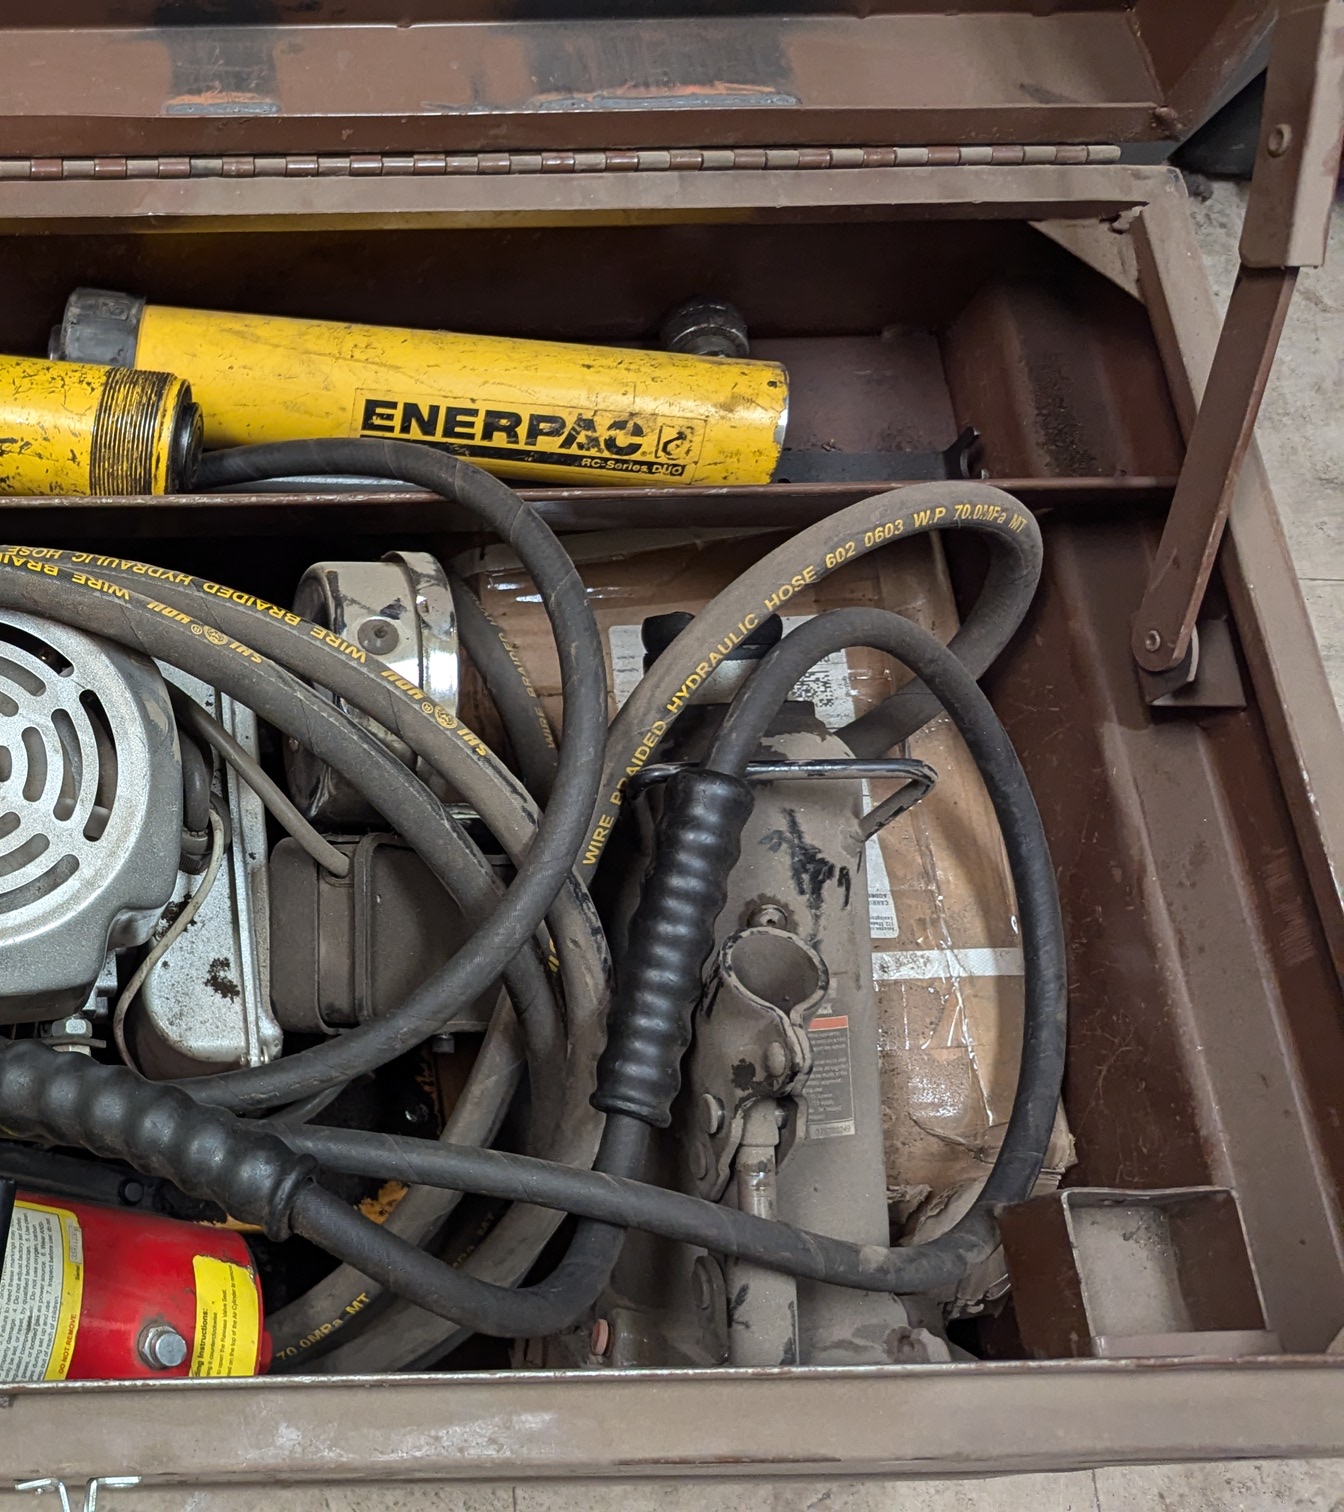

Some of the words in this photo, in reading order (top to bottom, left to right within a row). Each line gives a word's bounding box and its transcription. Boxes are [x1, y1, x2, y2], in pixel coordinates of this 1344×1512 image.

[361, 398, 644, 459] ENERPAC
[581, 456, 649, 475] RC-Series
[653, 463, 684, 477] DUO
[6, 544, 64, 559] HOSE
[71, 551, 194, 586] HYDRAULIC
[72, 571, 132, 601] WIRE
[202, 581, 302, 627] BRAIDED
[309, 627, 367, 664] WIRE
[582, 813, 615, 866] WIRE
[666, 612, 760, 714] HYDRAULIC
[764, 565, 818, 613] HOSE
[824, 541, 857, 570] 602
[864, 518, 905, 549] 0603
[913, 506, 947, 529] W.P
[1006, 513, 1028, 534] MT
[345, 1292, 370, 1316] MT
[65, 1313, 76, 1345] REMOVE
[197, 1307, 209, 1358] Instructions:
[57, 1362, 65, 1374] DO
[61, 1346, 70, 1362] NOT
